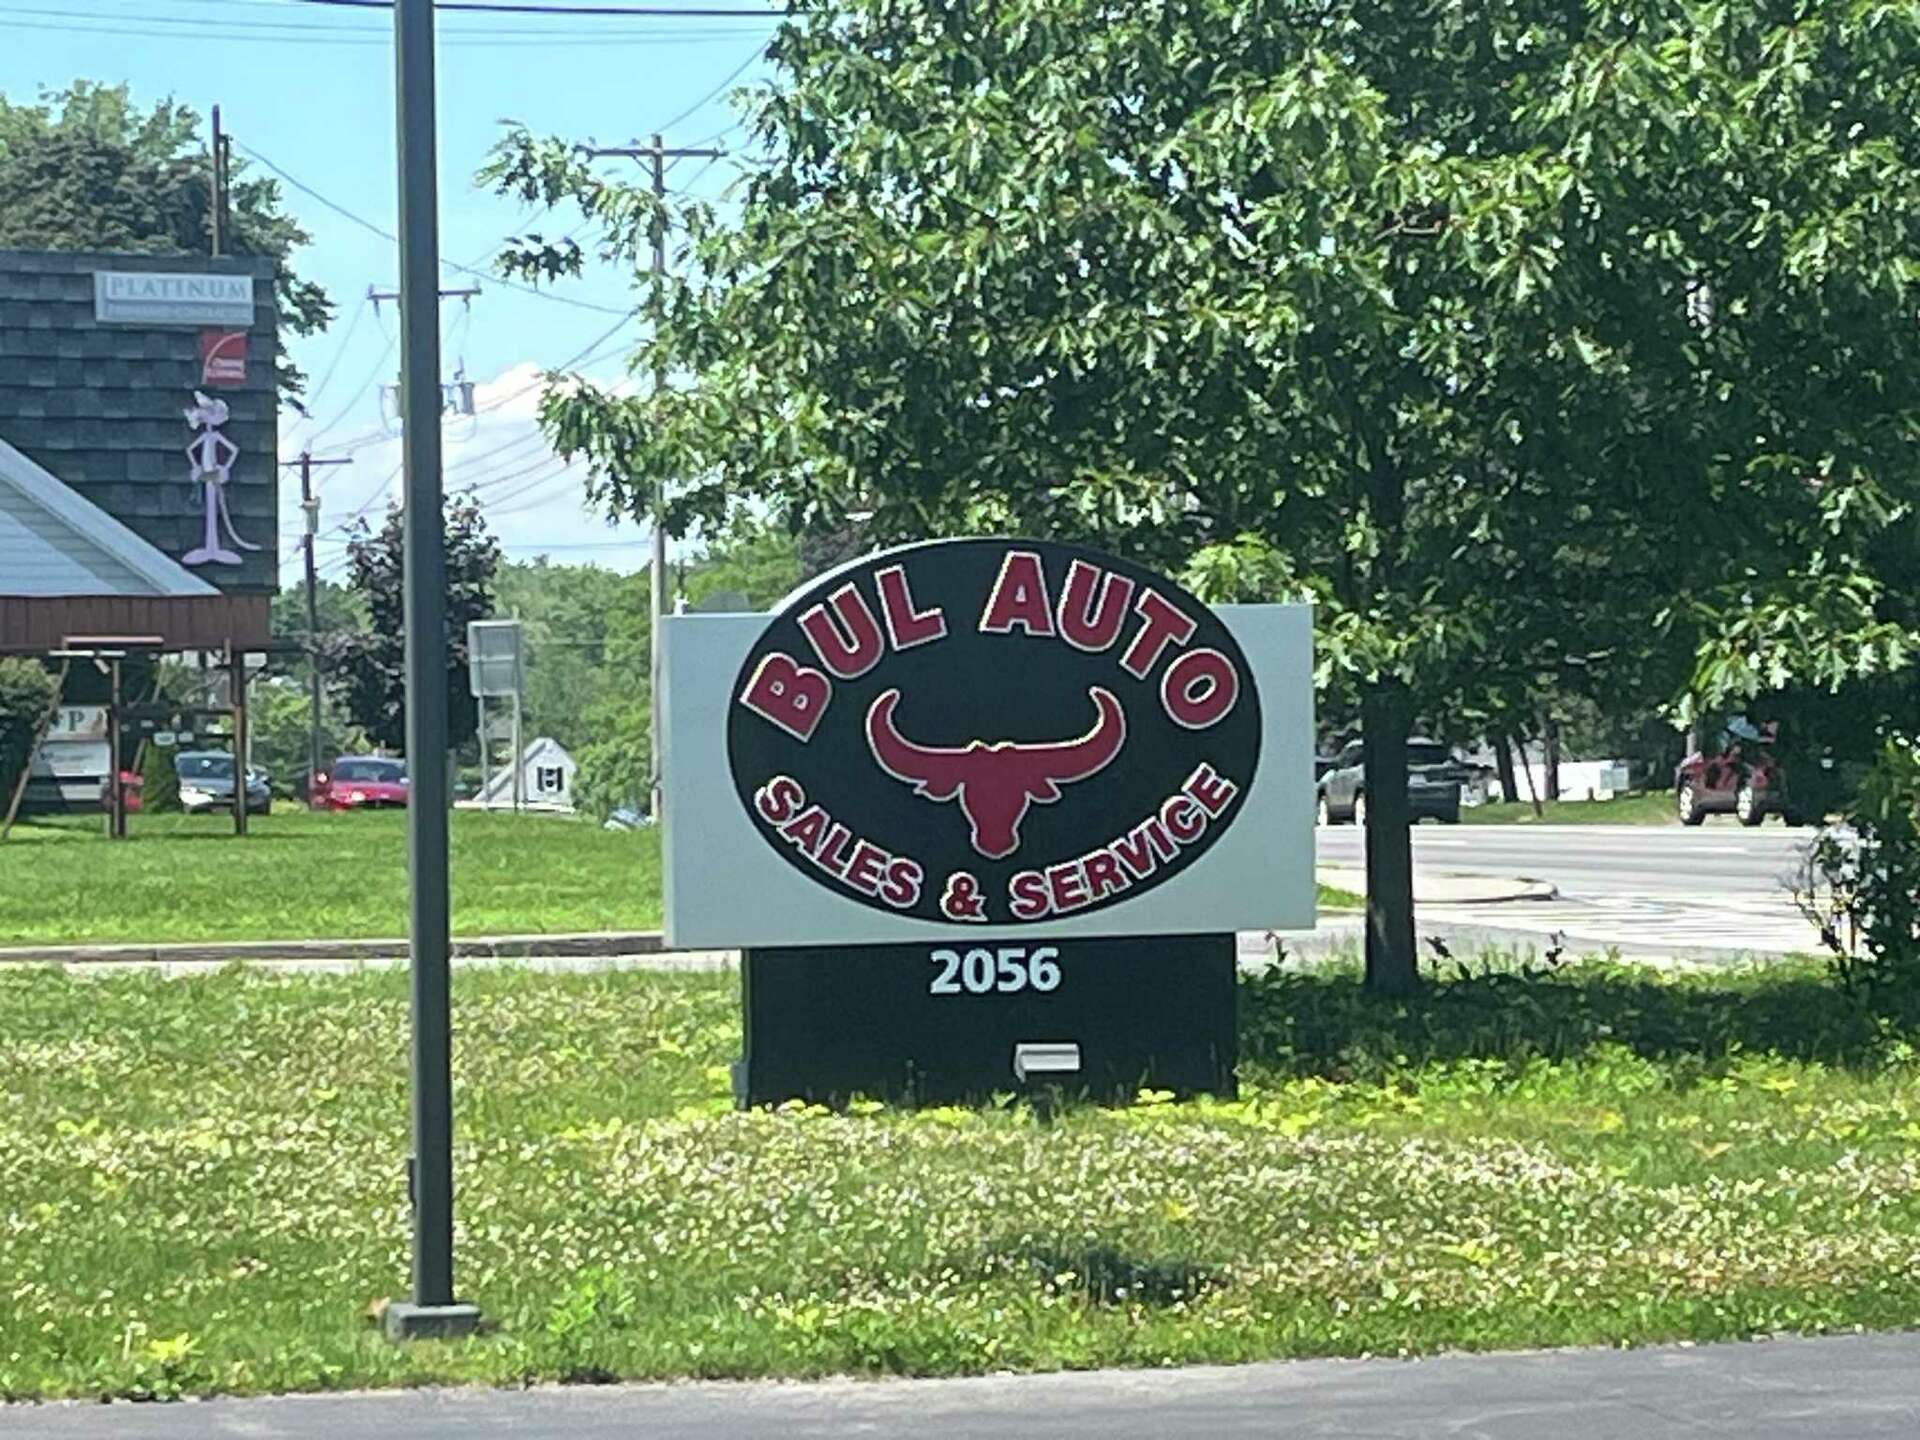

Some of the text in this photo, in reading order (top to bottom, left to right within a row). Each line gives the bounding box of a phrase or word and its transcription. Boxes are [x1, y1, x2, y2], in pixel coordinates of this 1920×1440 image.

[111, 277, 248, 299] PLATINUM
[740, 550, 1240, 742] BUL AUTO
[754, 762, 1238, 922] SALES & SERVICE
[929, 946, 1062, 994] 2056
